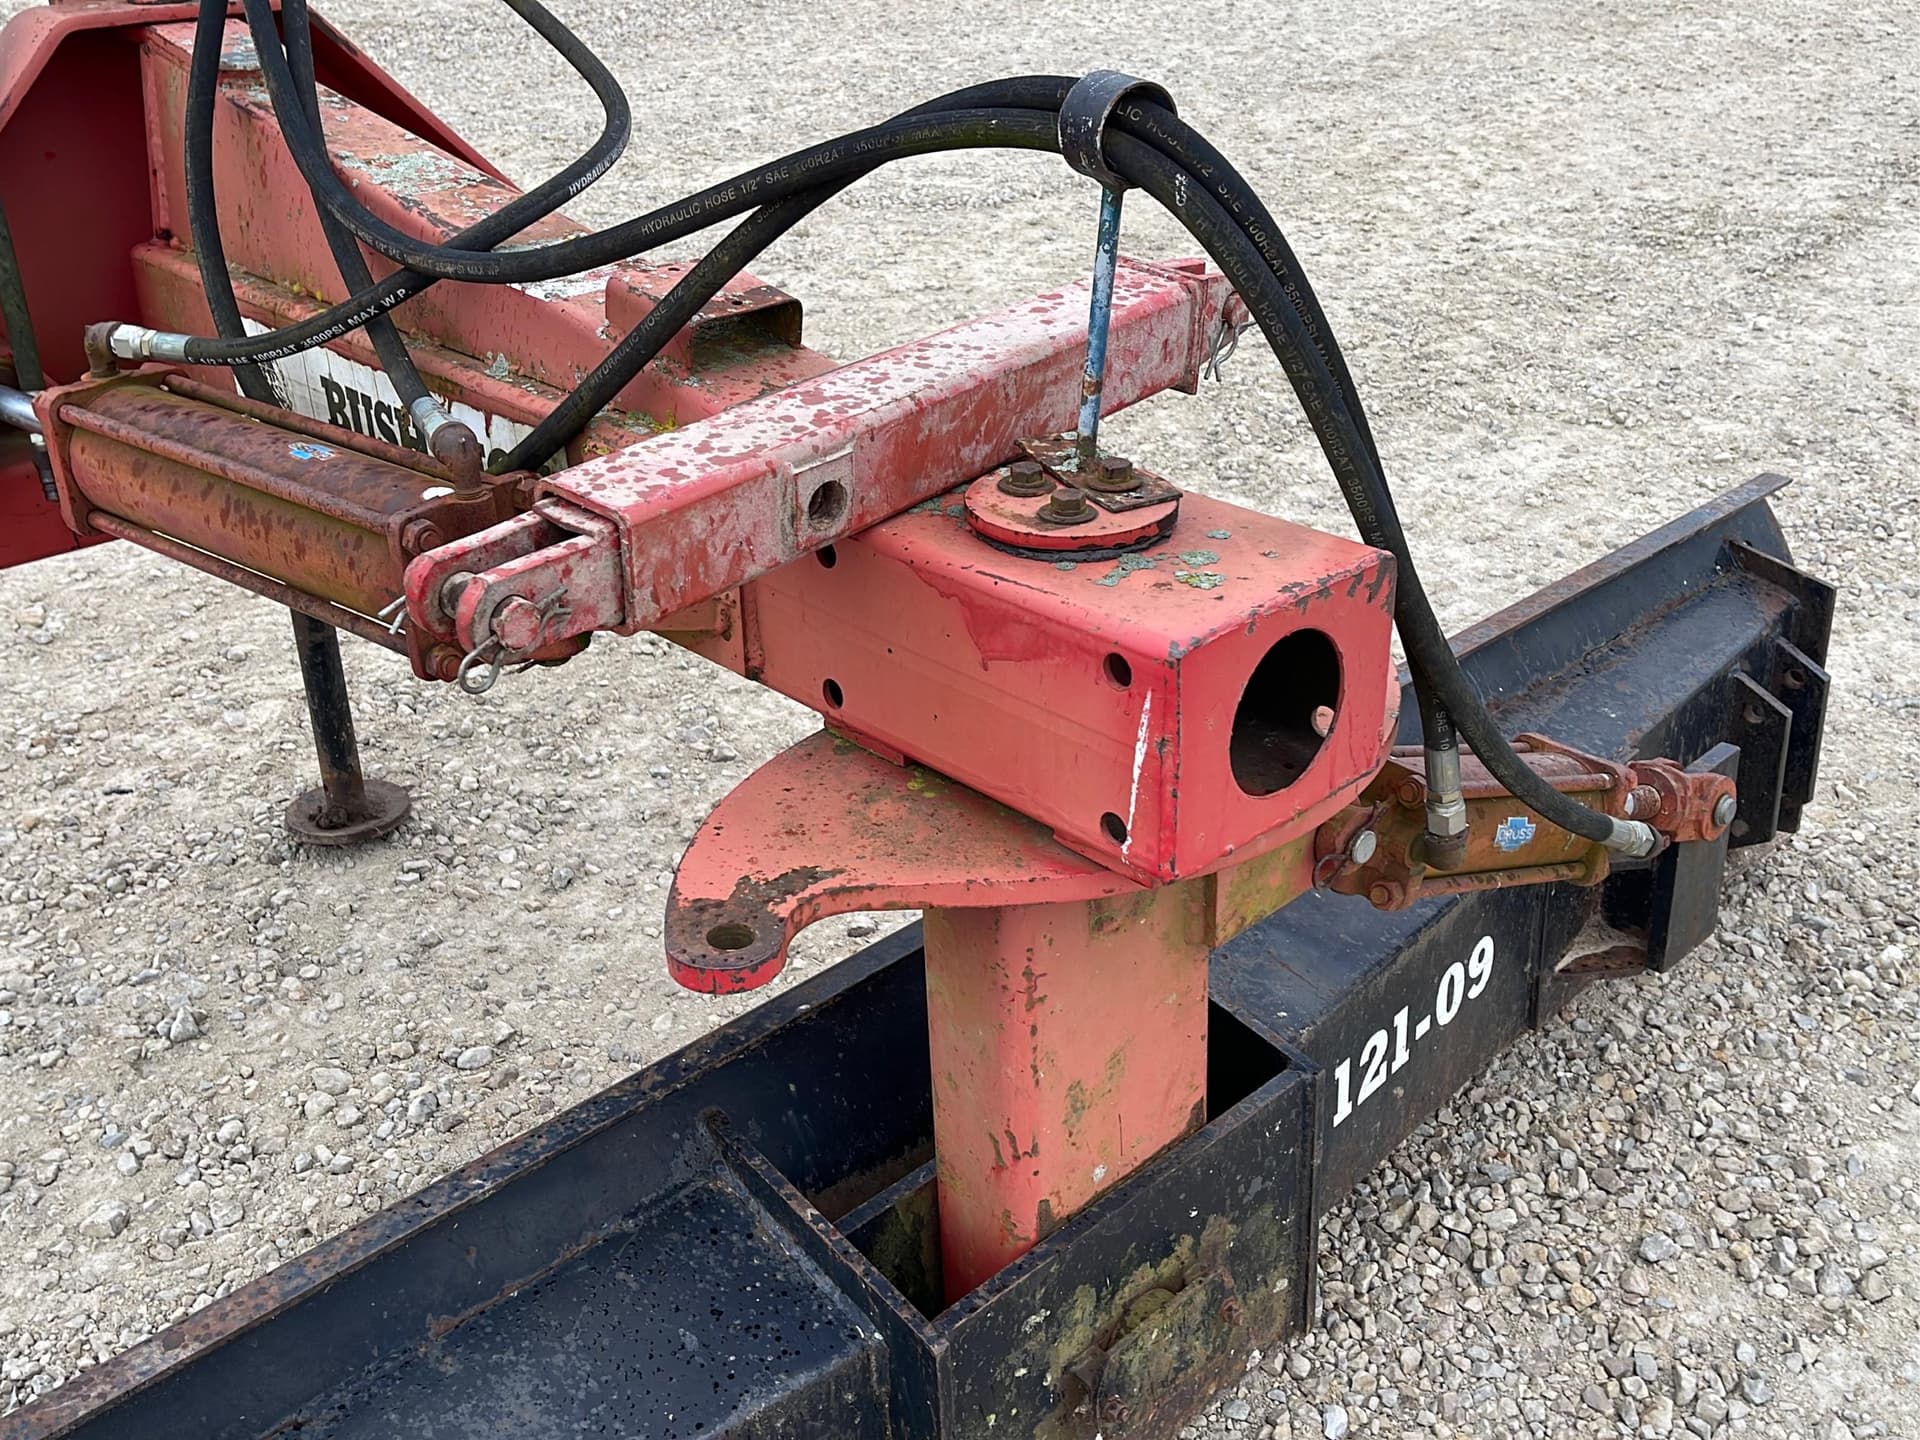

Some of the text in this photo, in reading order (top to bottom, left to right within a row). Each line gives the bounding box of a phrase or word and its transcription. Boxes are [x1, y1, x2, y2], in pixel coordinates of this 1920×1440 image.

[640, 205, 701, 236] HYDRAULIC
[704, 187, 737, 208] HOSE
[765, 166, 790, 184] SAE
[253, 343, 298, 363] 100R2AT
[302, 324, 346, 349] 3500PSI
[347, 305, 380, 328] MAX
[640, 303, 668, 335] HOSE
[1258, 301, 1289, 346] HOSE
[1434, 711, 1449, 733] SAE
[1333, 935, 1495, 1128] 121-09
